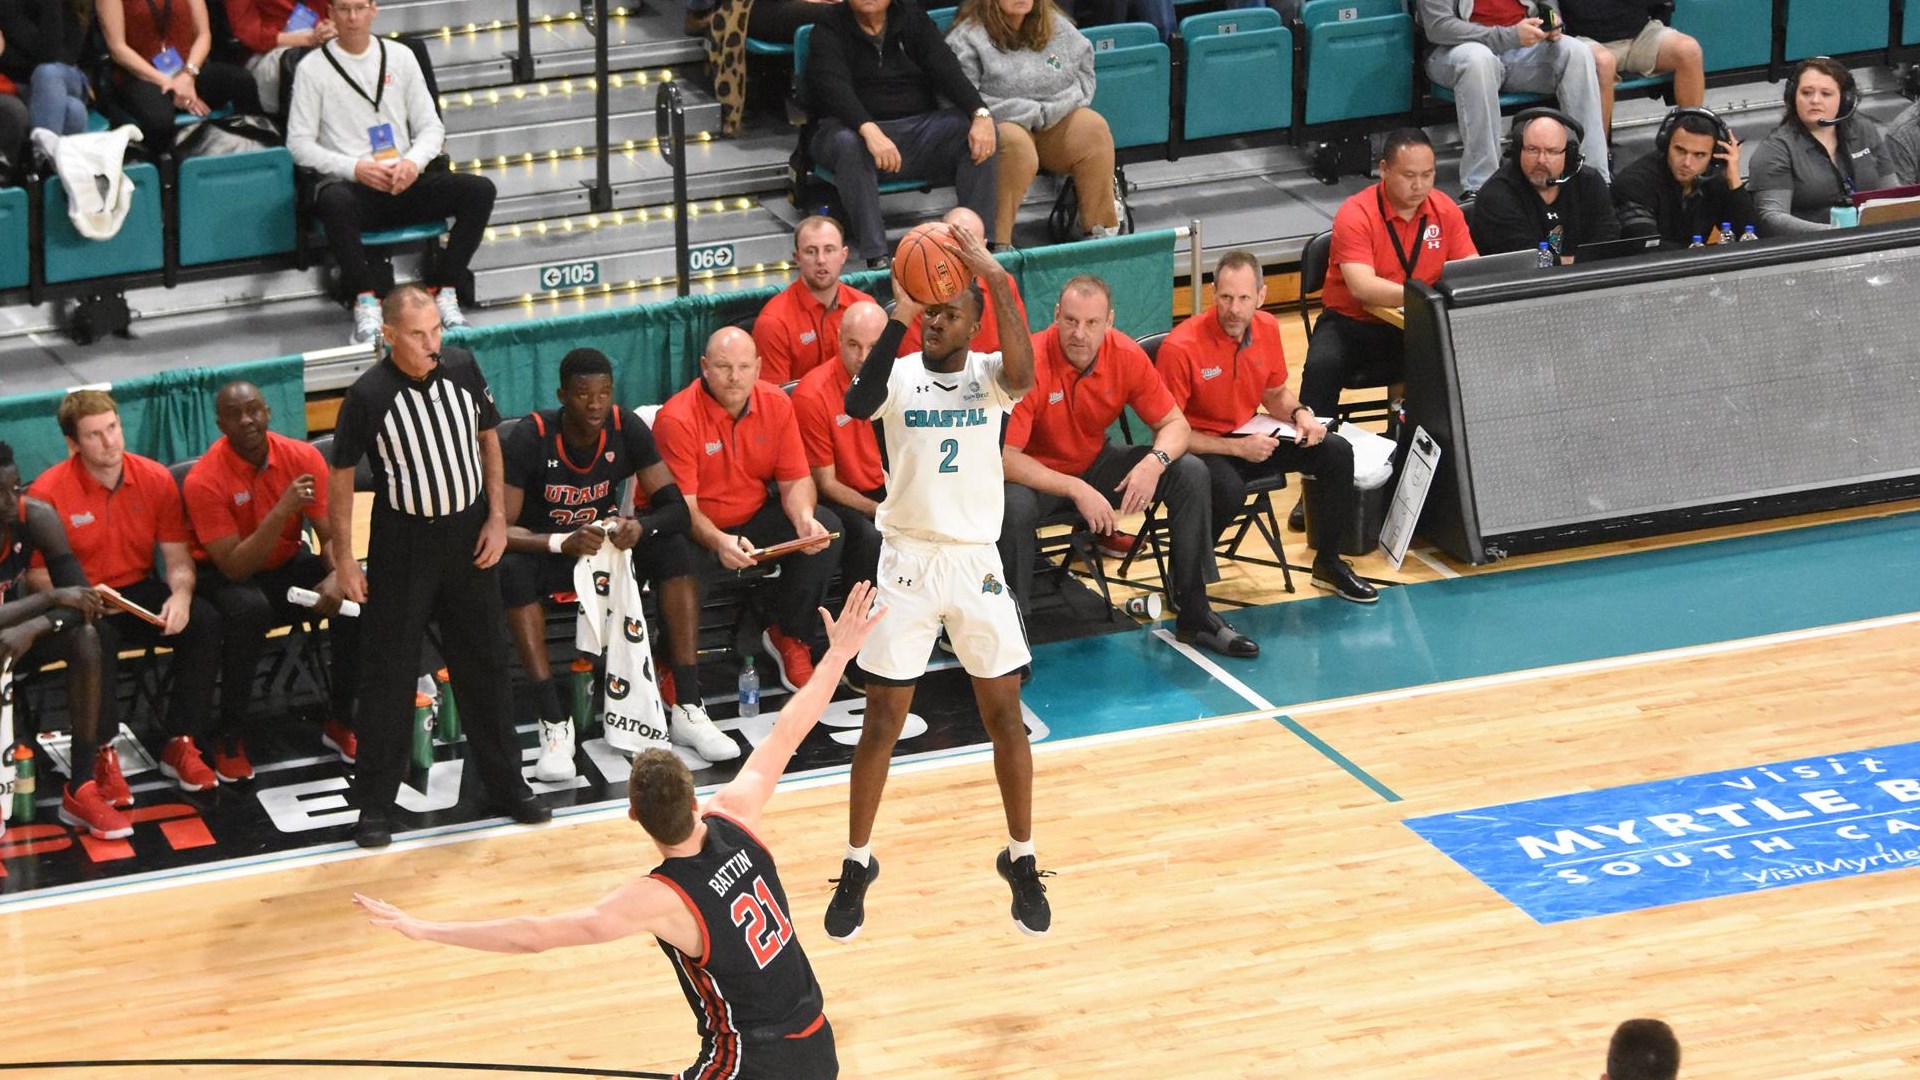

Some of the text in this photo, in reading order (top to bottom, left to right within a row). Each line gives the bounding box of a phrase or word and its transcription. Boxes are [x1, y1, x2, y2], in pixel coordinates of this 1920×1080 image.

[562, 264, 595, 285] 105
[689, 249, 715, 270] 06
[904, 408, 987, 428] COASTAL
[939, 438, 959, 474] 2
[544, 480, 611, 506] UTAH
[1721, 758, 1888, 791] visit
[1515, 788, 1862, 860] MYRTLE
[708, 849, 753, 898] BATTIN
[1556, 836, 1796, 885] SOUTH
[1742, 845, 1920, 884] VisitMyrtle
[730, 874, 793, 970] 21
